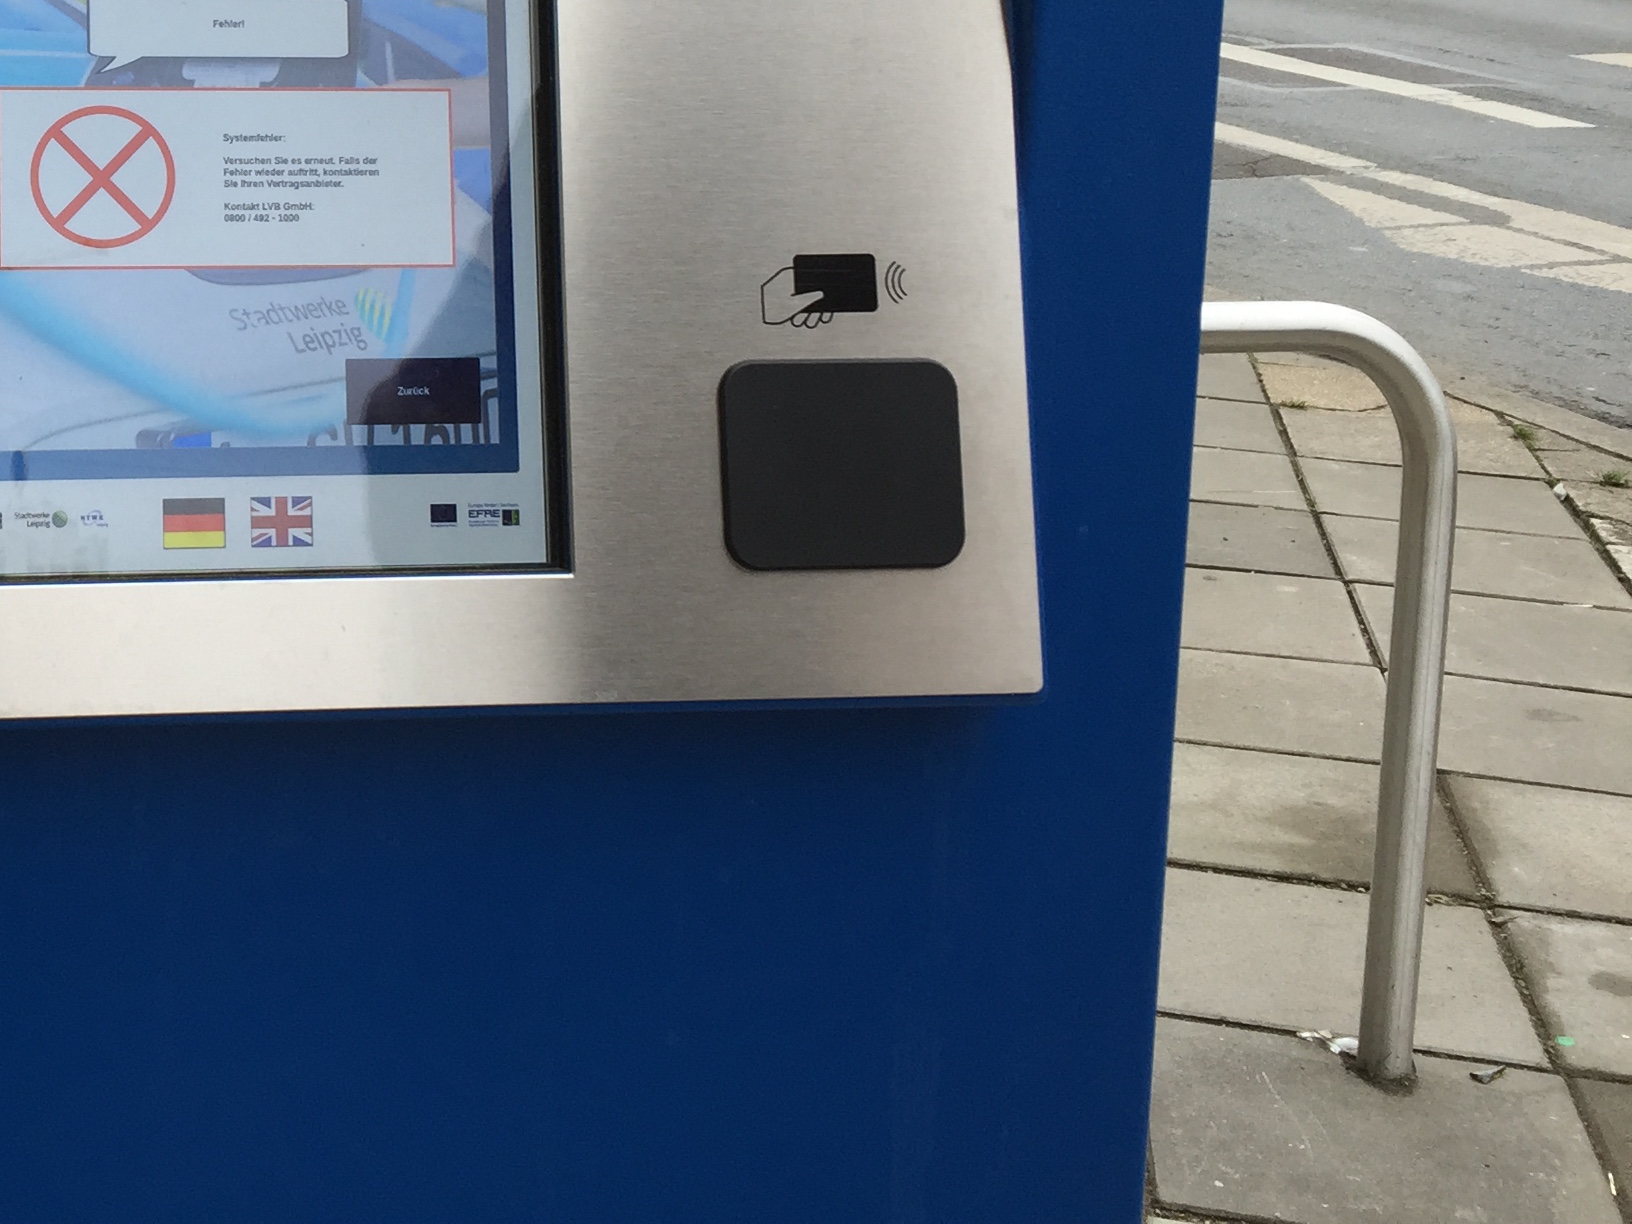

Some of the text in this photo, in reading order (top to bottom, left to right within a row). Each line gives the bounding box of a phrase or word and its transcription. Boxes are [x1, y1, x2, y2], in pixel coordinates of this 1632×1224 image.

[213, 19, 245, 29] Fehler!
[223, 133, 286, 144] Systemfehler:
[223, 156, 272, 165] Versuchen
[274, 156, 289, 165] Sie
[338, 157, 360, 165] Falls
[362, 157, 378, 165] der
[223, 168, 380, 178] Fehler wieder auftritt, kontaktieren
[223, 179, 345, 190] Sie Ihren Vertragsanbieter.
[224, 202, 260, 211] Kontakt
[262, 202, 281, 211] LVB
[228, 296, 350, 331] Stadtwerke
[286, 323, 368, 355] Leipzig
[397, 385, 430, 396] Zurück
[468, 509, 500, 518] EFRE
